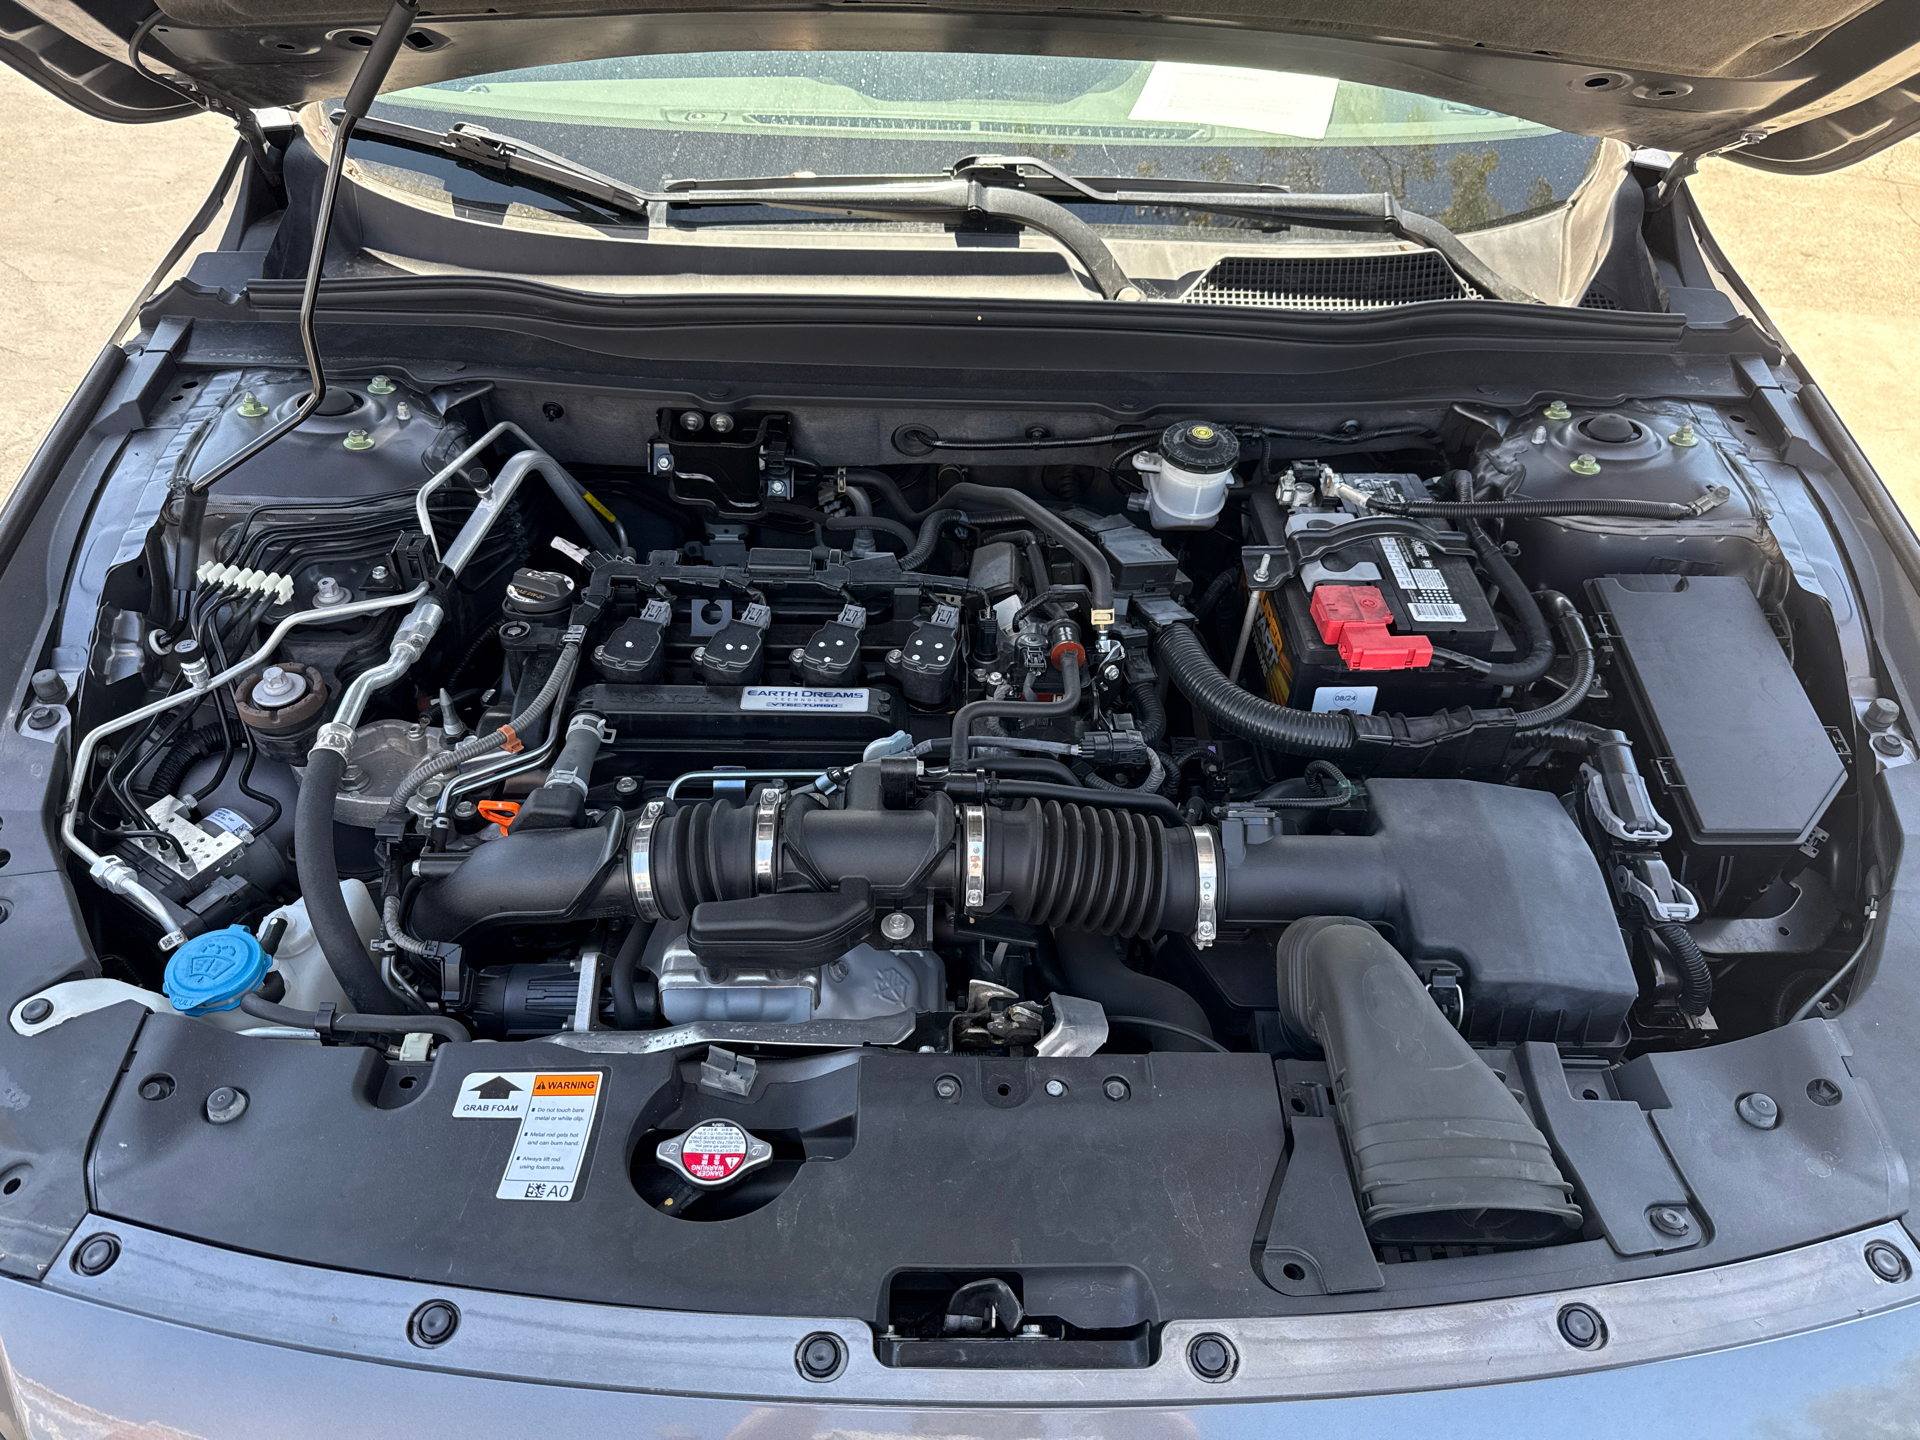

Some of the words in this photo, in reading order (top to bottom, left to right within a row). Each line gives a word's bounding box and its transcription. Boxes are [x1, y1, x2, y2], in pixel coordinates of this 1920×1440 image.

[610, 691, 722, 705] HONDA
[747, 689, 798, 697] EARTH
[801, 690, 864, 699] DREAMS
[172, 998, 194, 1006] PULL
[548, 1081, 595, 1089] WARNING
